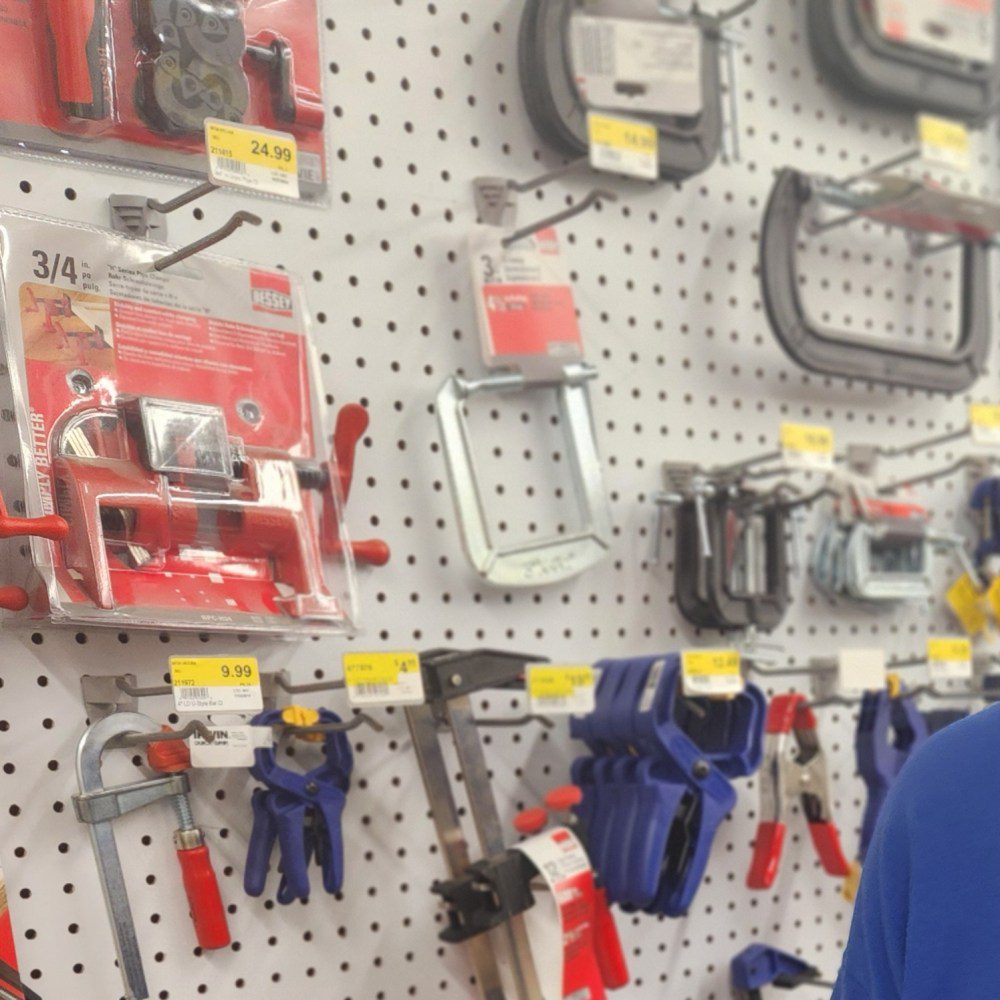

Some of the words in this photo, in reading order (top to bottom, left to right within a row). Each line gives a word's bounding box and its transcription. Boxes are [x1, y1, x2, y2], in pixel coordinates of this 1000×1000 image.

[251, 140, 292, 162] 24.99
[32, 250, 77, 285] 3/4
[221, 664, 252, 679] 9.99
